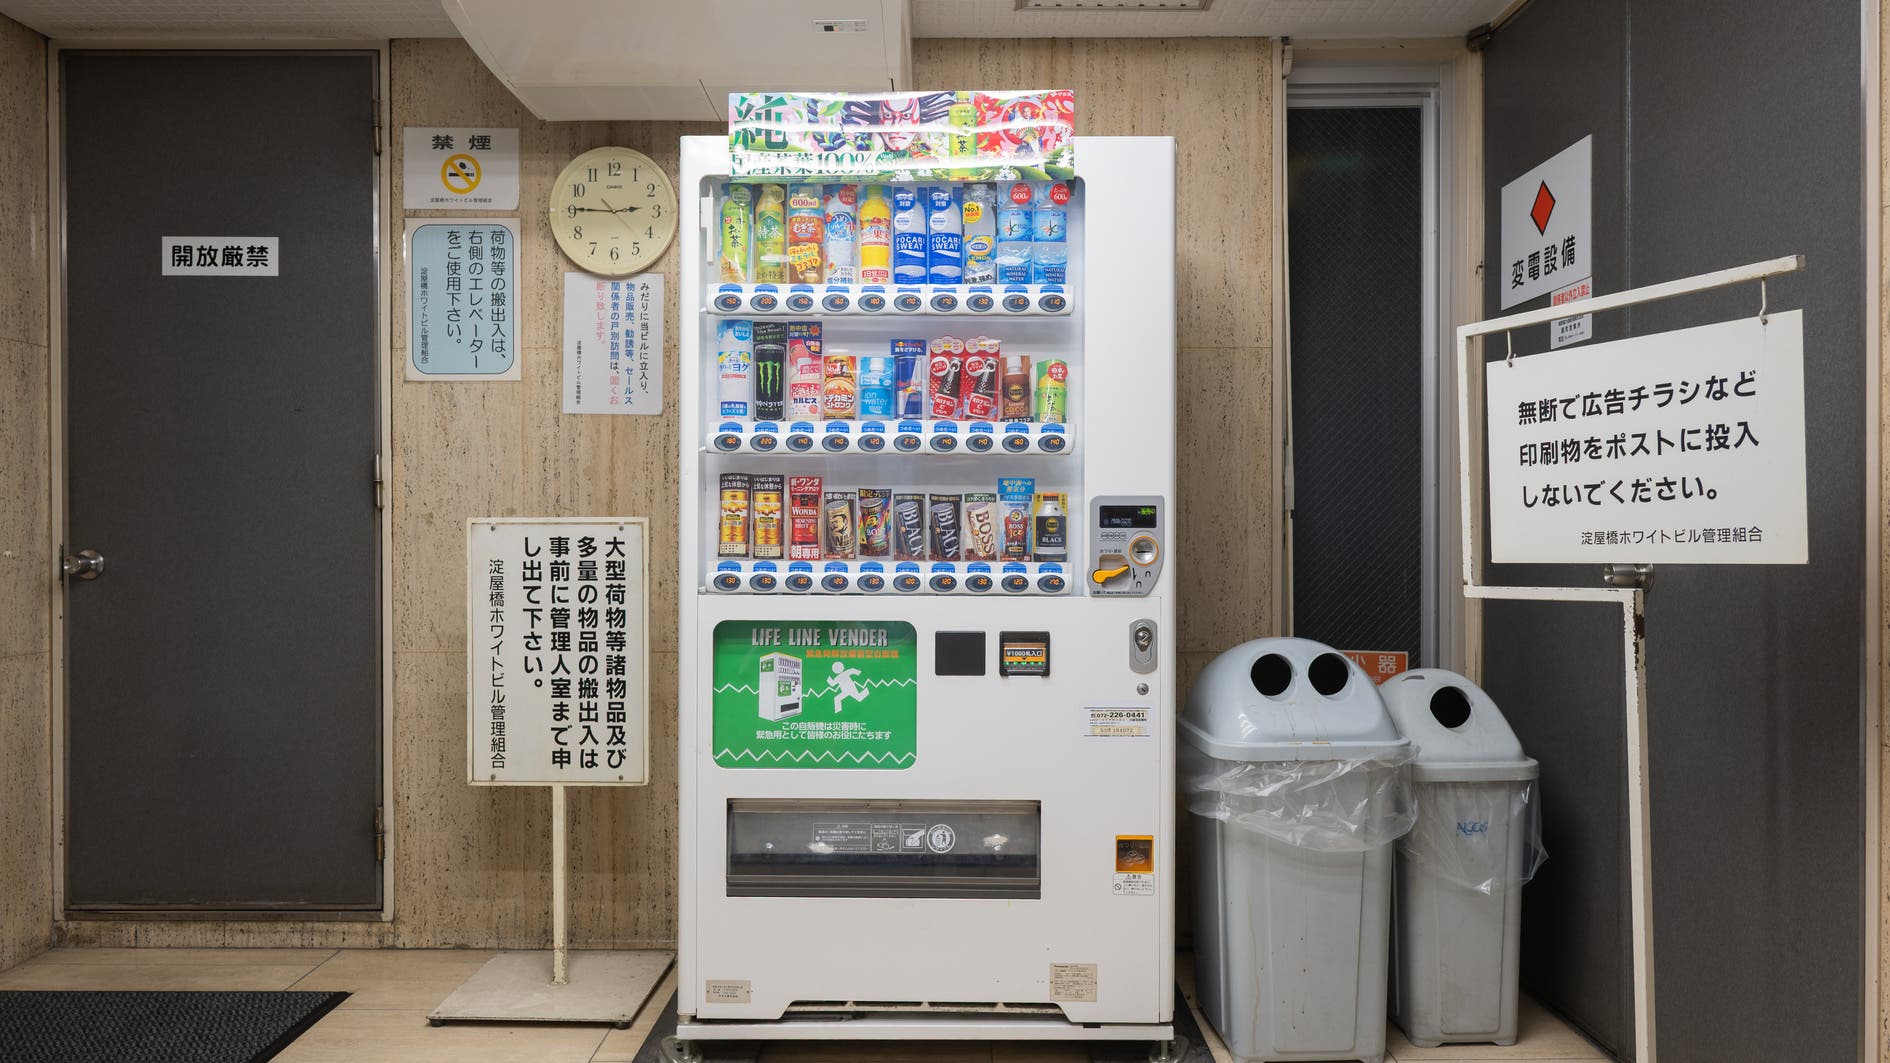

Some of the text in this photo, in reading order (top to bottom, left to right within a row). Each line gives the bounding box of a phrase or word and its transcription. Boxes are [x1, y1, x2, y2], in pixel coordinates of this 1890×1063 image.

[588, 168, 598, 182] 11
[608, 162, 621, 176] 12
[633, 168, 637, 182] 1
[573, 183, 585, 197] 10
[646, 183, 655, 197] 2
[567, 204, 576, 219] 9
[652, 204, 661, 218] 3
[573, 226, 583, 240] 8
[644, 225, 653, 239] 4
[171, 245, 269, 268] 開放厳禁
[589, 242, 598, 255] 7
[610, 247, 619, 261] 6
[632, 242, 640, 255] 5
[1511, 234, 1576, 290] 変電設備
[446, 230, 462, 344] をご使用下さい。
[490, 229, 506, 359] 荷物等の搬出入は、
[468, 229, 484, 369] 右側のエレベーター
[639, 282, 650, 394] みだりに当ビルに立入り、
[1517, 369, 1758, 426] 無断で広告チラシなど
[1518, 420, 1760, 467] 印刷物をポストに投入
[1522, 476, 1718, 508] しないでください。
[791, 506, 817, 516] WONDA
[902, 509, 925, 556] BLACK
[937, 509, 960, 558] BLACK
[975, 510, 995, 554] BOSS
[1581, 525, 1763, 546] 淀屋橋ホワイトビル管理組合
[791, 545, 819, 559] 朝専用
[521, 536, 544, 688] し出て下さい。
[752, 628, 888, 647] LIFE LINE VENDER
[548, 535, 572, 770] 事前に管理人室まで申
[576, 535, 600, 769] 多量の物品の搬出入は
[604, 536, 628, 769] 大型荷物等諸物品及び
[488, 558, 506, 769] 淀屋橋ホワイトビル管理組合
[782, 721, 867, 731] この自販機は災害時に
